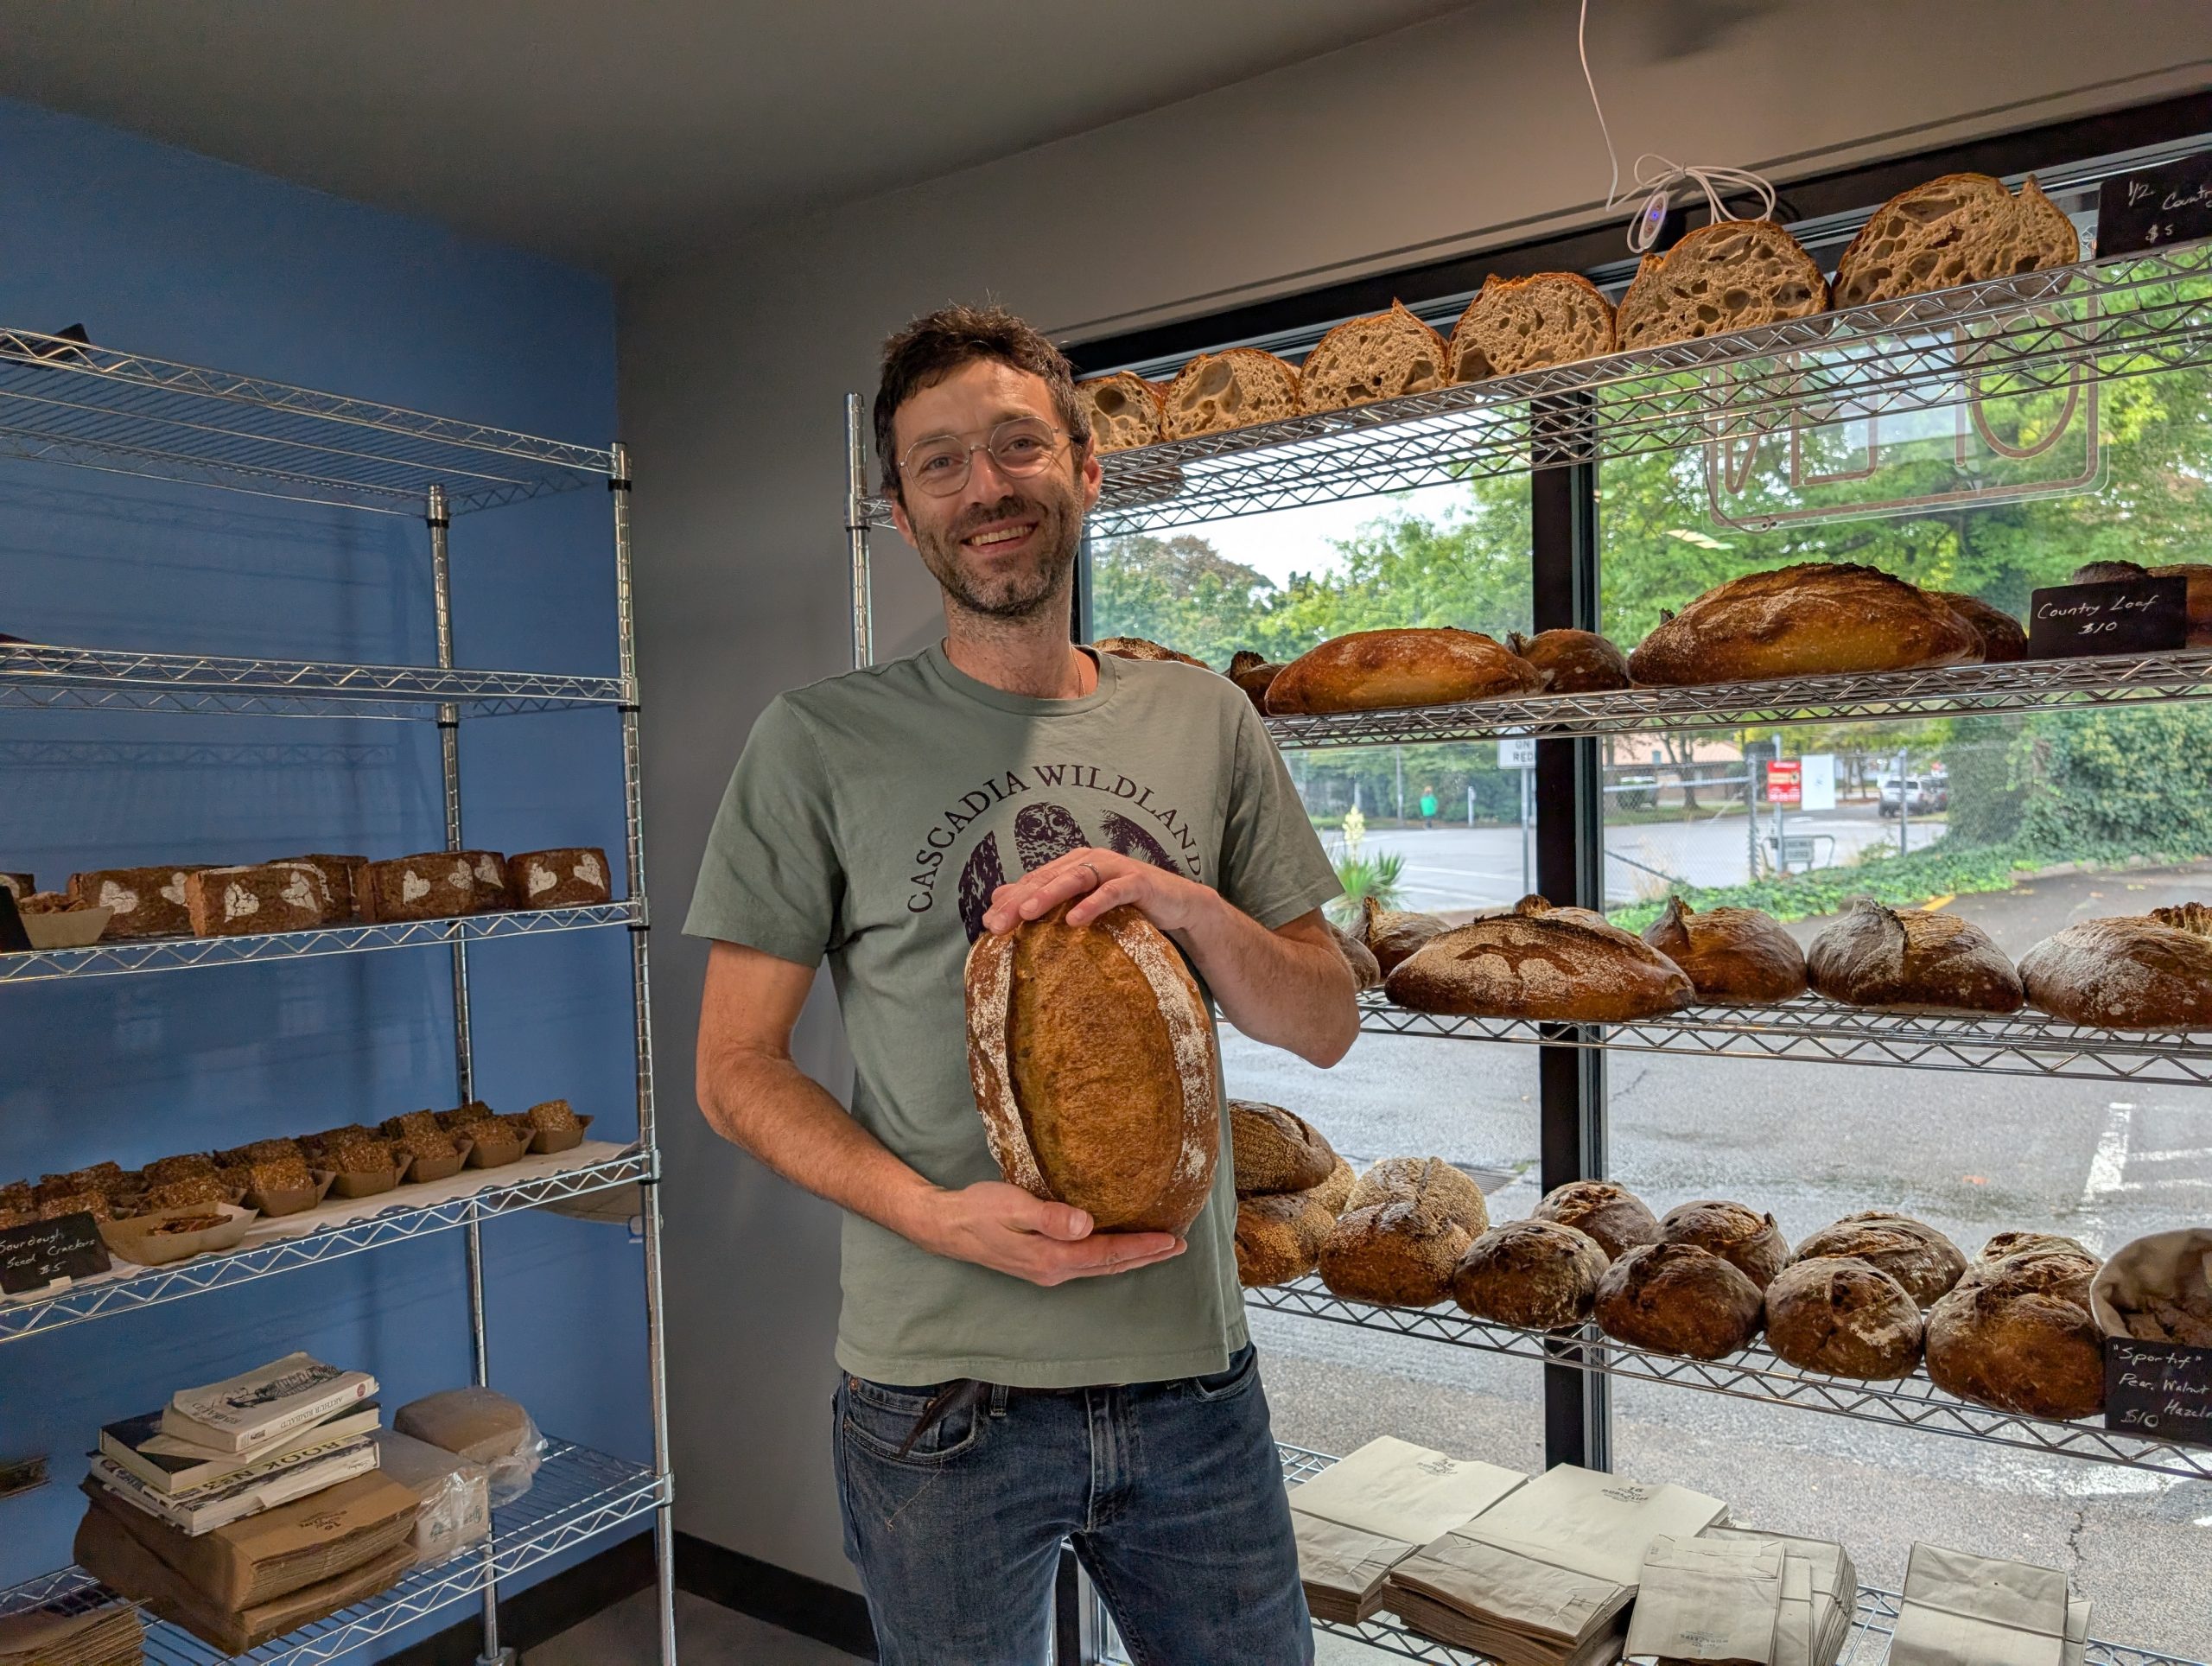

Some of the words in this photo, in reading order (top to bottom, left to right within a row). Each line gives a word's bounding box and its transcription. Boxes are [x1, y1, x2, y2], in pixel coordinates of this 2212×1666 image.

[2162, 184, 2212, 210] Countr
[2037, 602, 2101, 620] Country
[2109, 595, 2159, 612] Loaf
[2077, 621, 2117, 634] $10
[1513, 752, 1534, 762] RED
[907, 770, 1031, 913] CASCADIA
[1032, 764, 1202, 884] WILDLAND
[0, 1228, 66, 1253] Sourdough
[7, 1253, 36, 1269] Seed
[39, 1261, 67, 1275] $5
[315, 1396, 344, 1415] ARTHUR
[280, 1408, 315, 1428] RIMBAUD
[2120, 1408, 2159, 1428] $10
